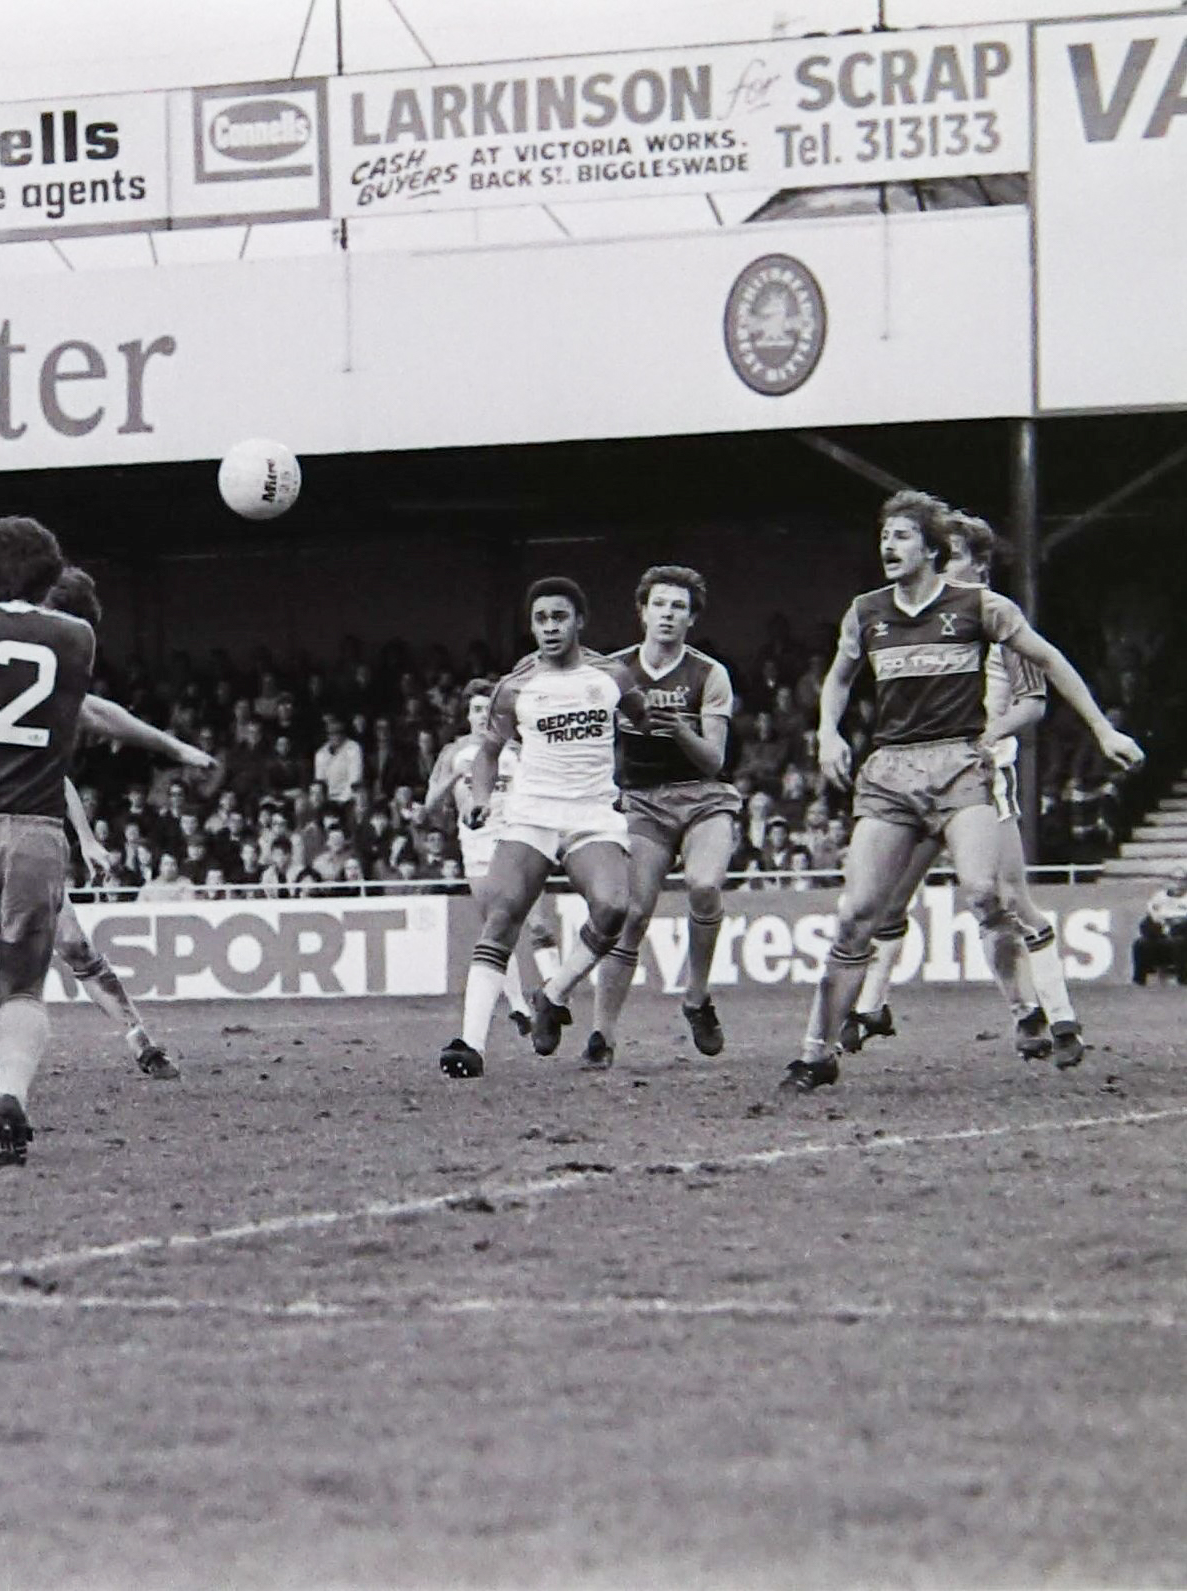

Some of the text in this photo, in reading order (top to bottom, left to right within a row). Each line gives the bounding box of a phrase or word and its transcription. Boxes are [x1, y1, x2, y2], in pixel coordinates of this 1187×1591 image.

[351, 42, 1011, 146] LARKINSON for SCRAP
[215, 110, 309, 149] Connells
[775, 111, 1001, 168] Tel. 313133
[351, 150, 427, 186] CASH
[469, 169, 532, 191] BACK
[577, 152, 750, 182] BIGGLESWADE
[470, 146, 501, 167] AT
[514, 137, 633, 163] VICTORIA
[22, 170, 146, 219] agents
[357, 163, 459, 206] BUYERS
[537, 709, 609, 733] BEDFORD
[546, 725, 604, 744] TRUCKS
